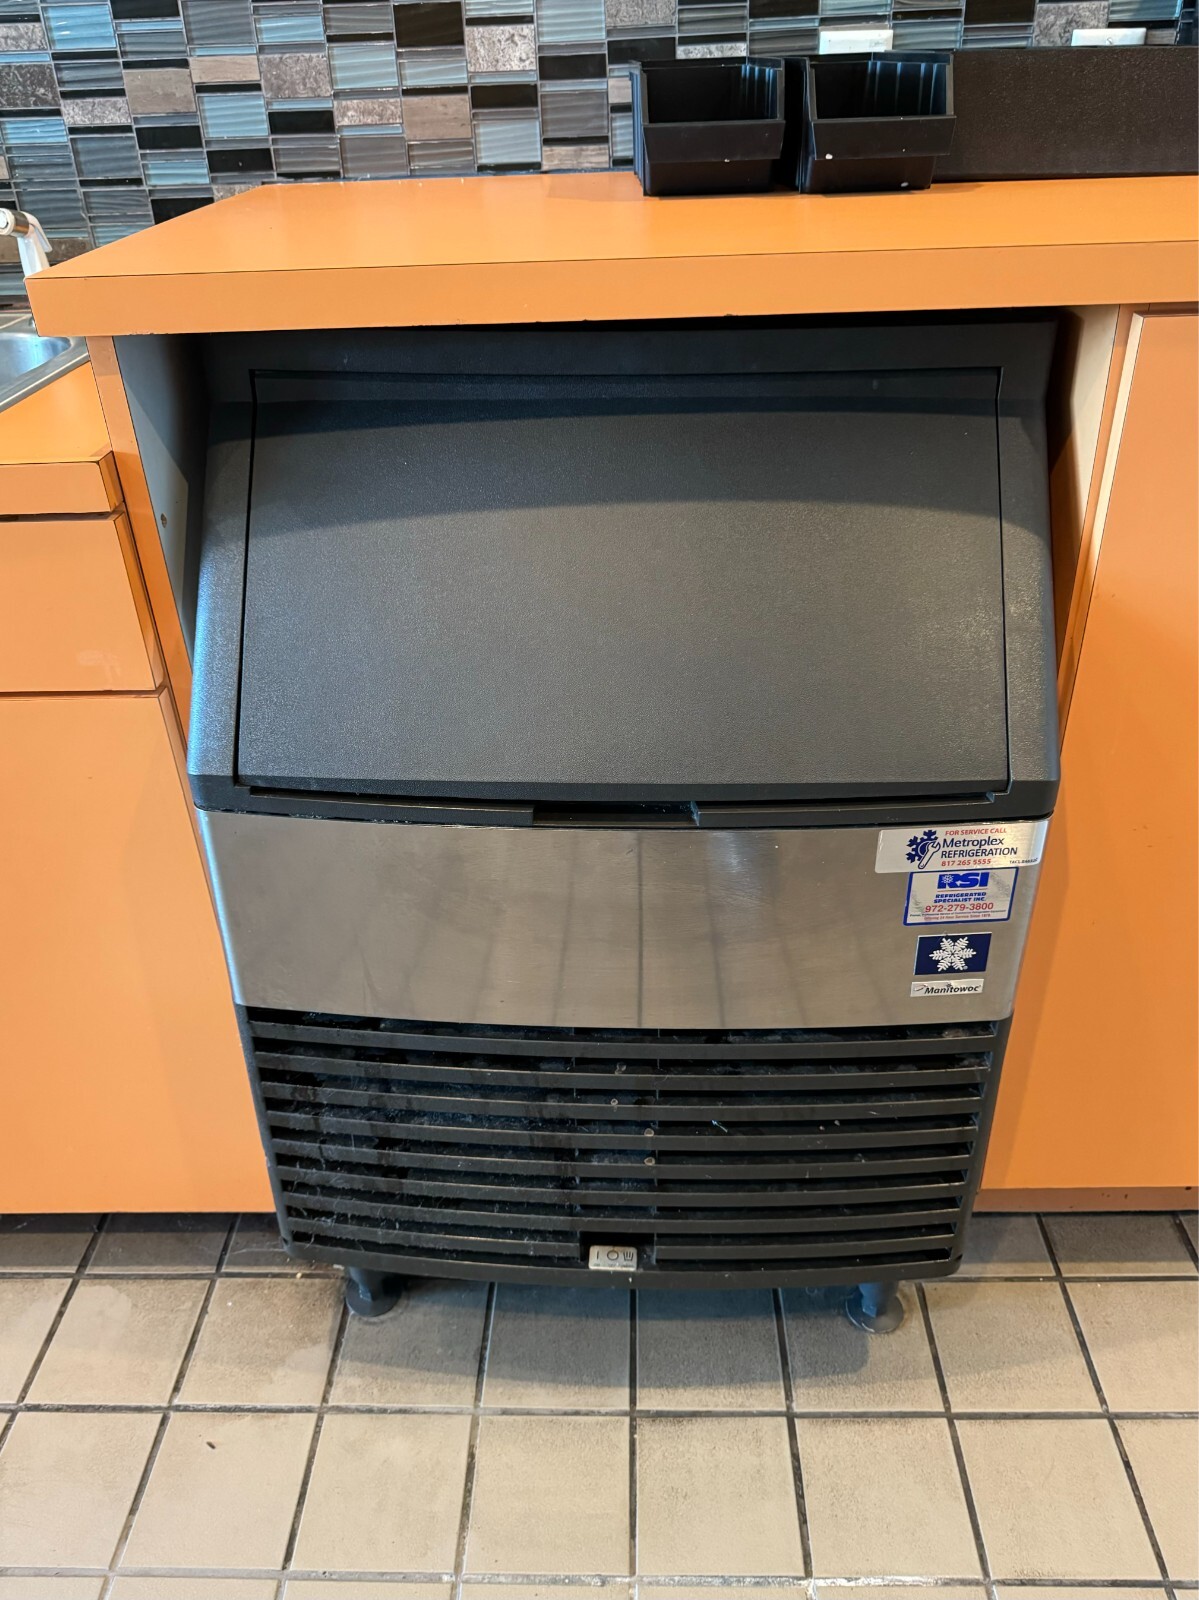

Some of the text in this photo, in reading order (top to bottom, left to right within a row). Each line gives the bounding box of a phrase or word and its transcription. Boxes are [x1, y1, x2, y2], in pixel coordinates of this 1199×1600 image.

[942, 836, 1004, 848] Metroplex
[941, 847, 1018, 858] REFRIGERATION
[937, 872, 990, 889] RSI
[925, 902, 994, 913] 972-279-3800
[924, 985, 979, 994] Manitowoc
